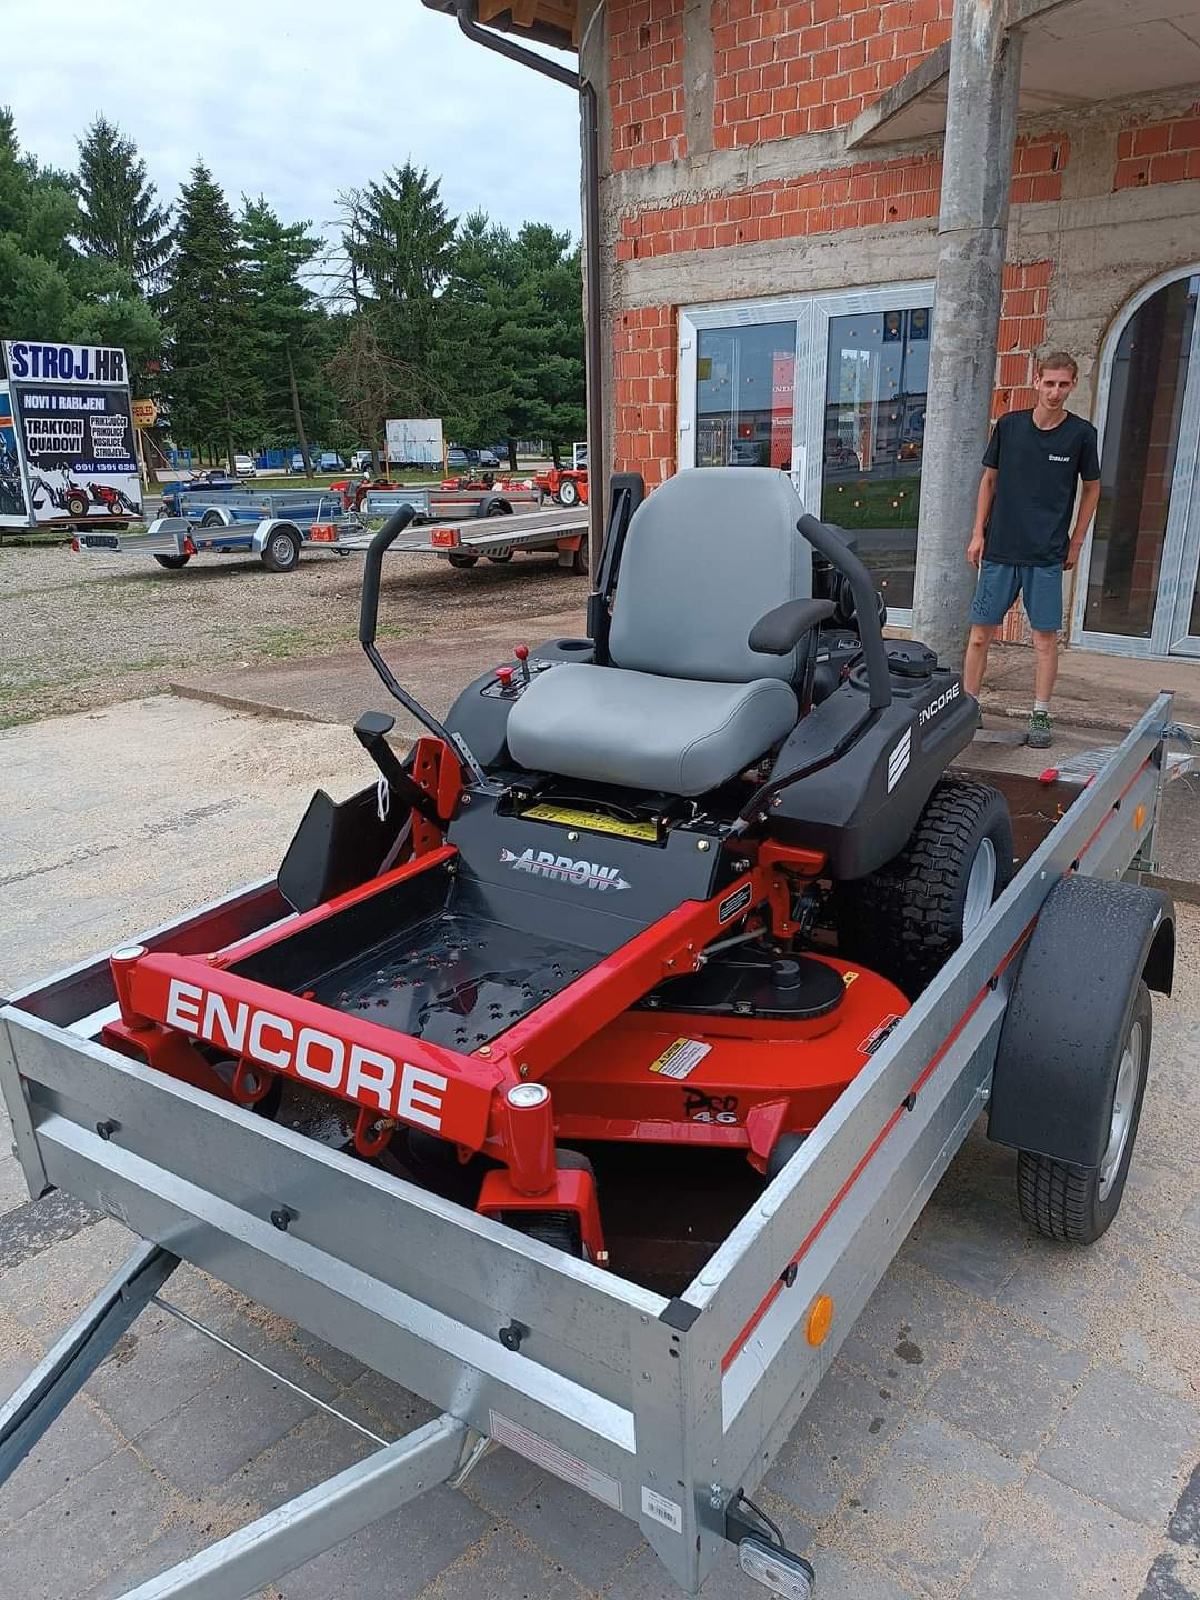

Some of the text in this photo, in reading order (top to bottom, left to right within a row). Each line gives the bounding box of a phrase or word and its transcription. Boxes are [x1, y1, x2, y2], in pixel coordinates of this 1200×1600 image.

[12, 344, 124, 381] STROJ.HR
[24, 395, 105, 410] NOVI I RABLJENI
[26, 419, 83, 436] TRAKTORI
[29, 436, 81, 454] QUADOVI
[512, 848, 620, 890] ARROW
[165, 978, 448, 1131] ENCORE
[692, 1112, 738, 1124] 46
